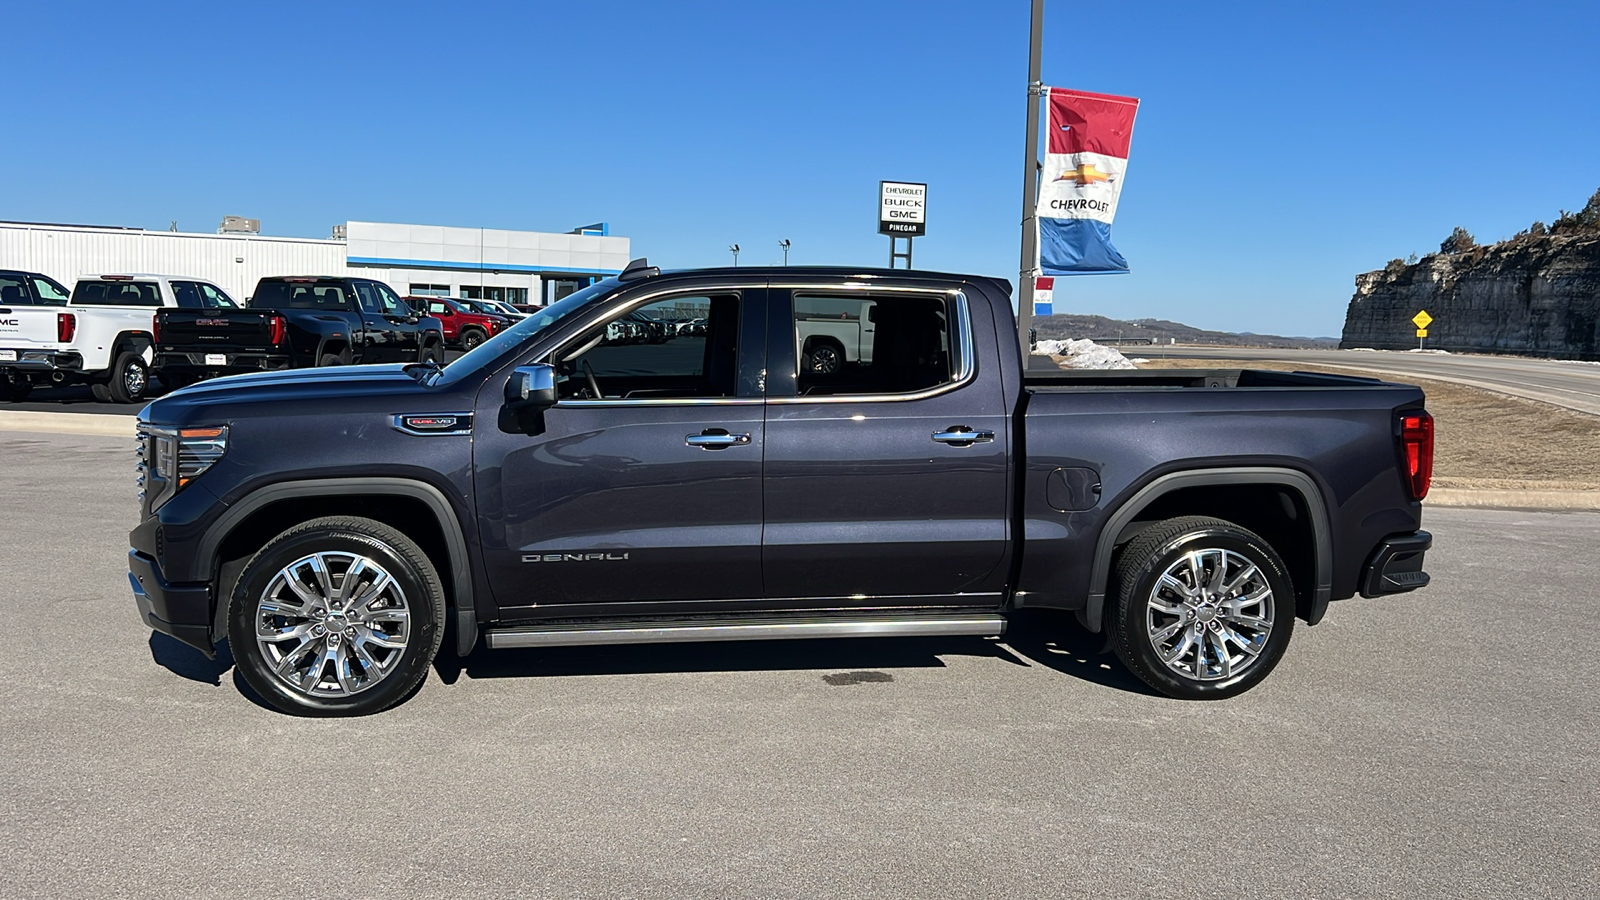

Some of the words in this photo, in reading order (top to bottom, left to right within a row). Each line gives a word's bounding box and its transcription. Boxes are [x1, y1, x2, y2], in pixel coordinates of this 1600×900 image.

[885, 187, 923, 195] CHEVROLET
[884, 198, 923, 207] BUICK
[1050, 199, 1109, 213] CHEVROLET
[889, 210, 918, 219] GMC
[889, 223, 917, 232] PINEGAR
[195, 318, 230, 326] GMC
[521, 552, 629, 563] DENALI
